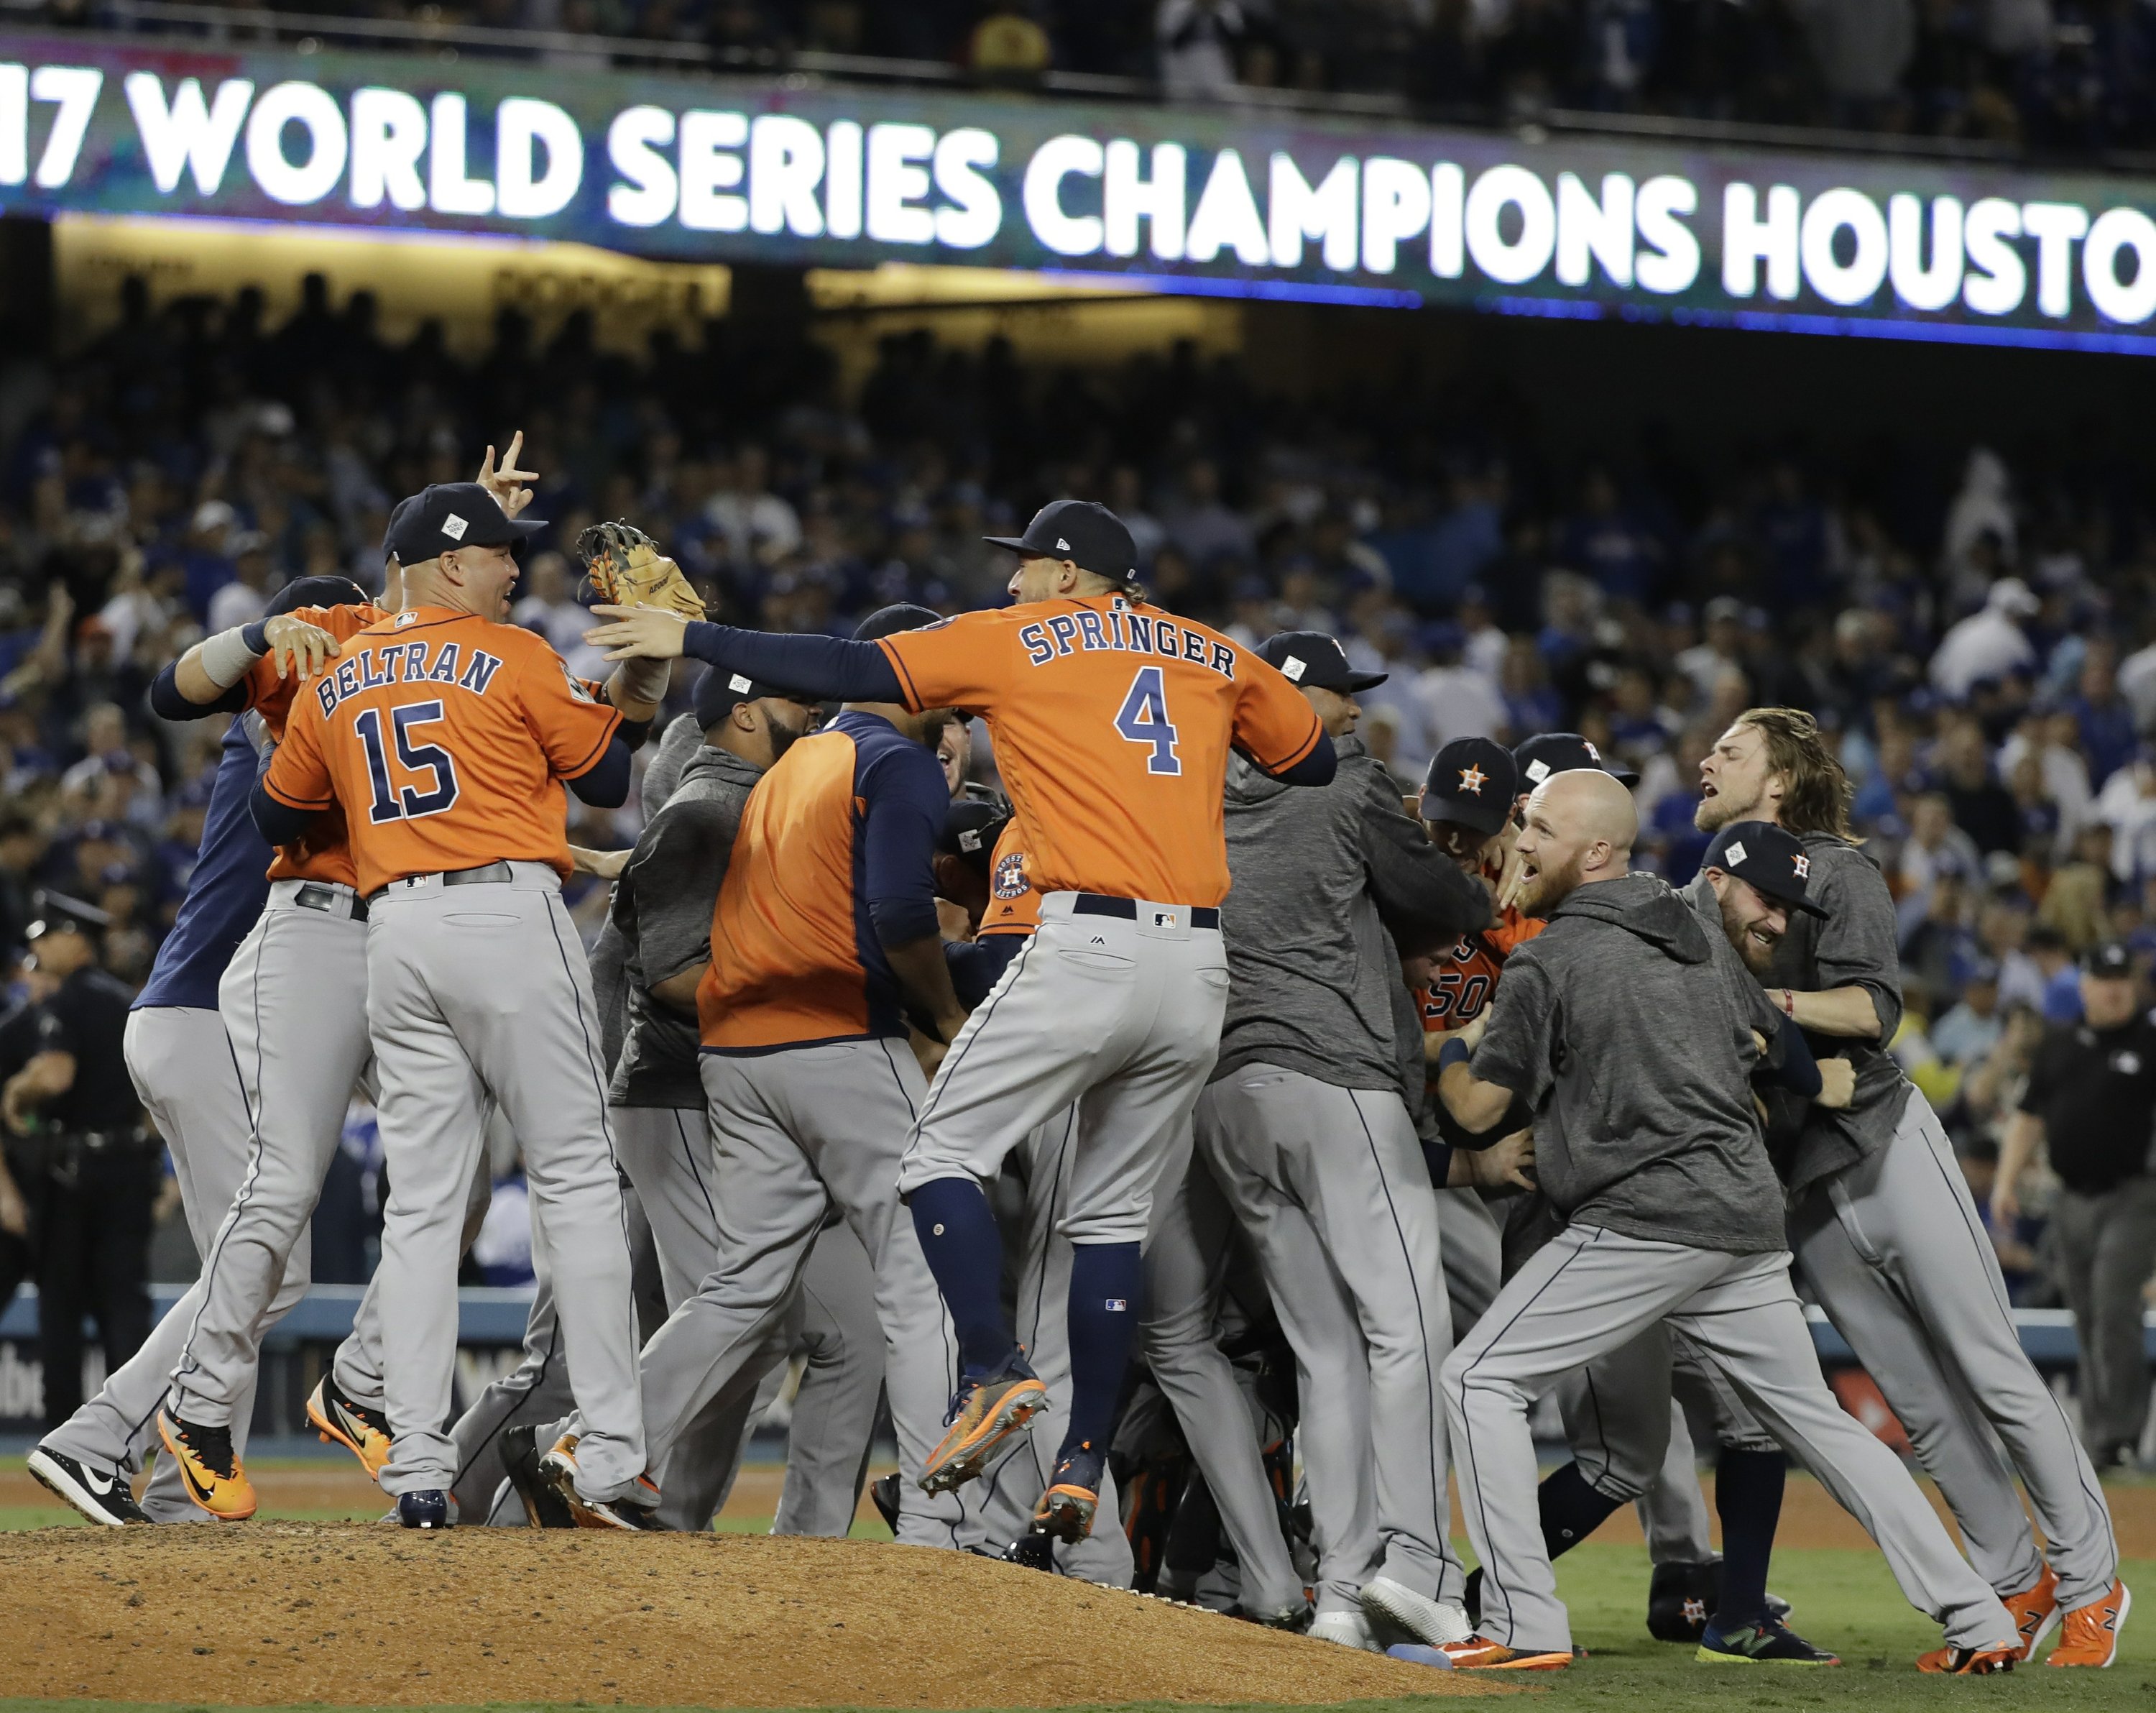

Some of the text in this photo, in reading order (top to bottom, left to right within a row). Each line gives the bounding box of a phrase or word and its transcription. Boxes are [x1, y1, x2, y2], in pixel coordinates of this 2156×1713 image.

[0, 63, 2156, 324] 17 WORLD SERIES CHAMPIONS HOUSTO
[1018, 610, 1235, 682] SPRINGER
[316, 641, 503, 721] BELTRAN
[1112, 666, 1182, 776] 4
[353, 699, 460, 825] 15
[1459, 768, 1485, 791] H
[997, 855, 1023, 873] HOUST
[1003, 868, 1021, 886] H
[1794, 853, 1810, 878] H
[996, 884, 1028, 898] ASTROS
[1424, 973, 1491, 1019] 50
